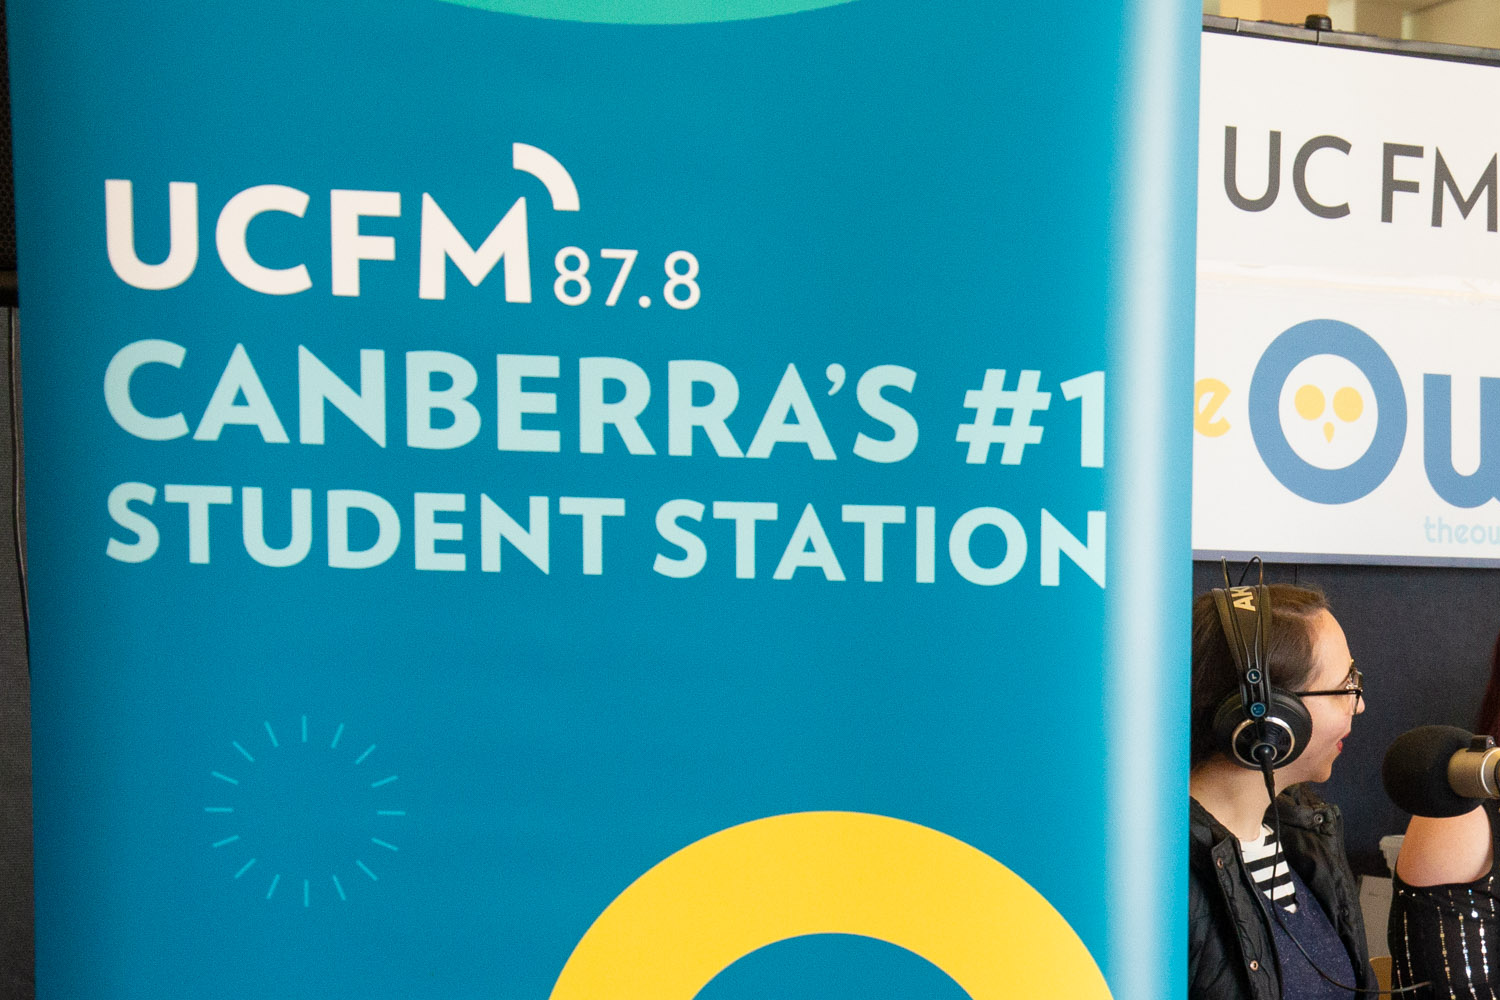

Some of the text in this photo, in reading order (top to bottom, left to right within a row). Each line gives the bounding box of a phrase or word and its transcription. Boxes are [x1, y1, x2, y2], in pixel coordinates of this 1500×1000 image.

[1223, 125, 1498, 232] UC FM
[105, 179, 701, 310] UCFM 87.8
[104, 339, 1105, 468] CANBERRA’S #1
[106, 482, 1107, 589] STUDENT STATION
